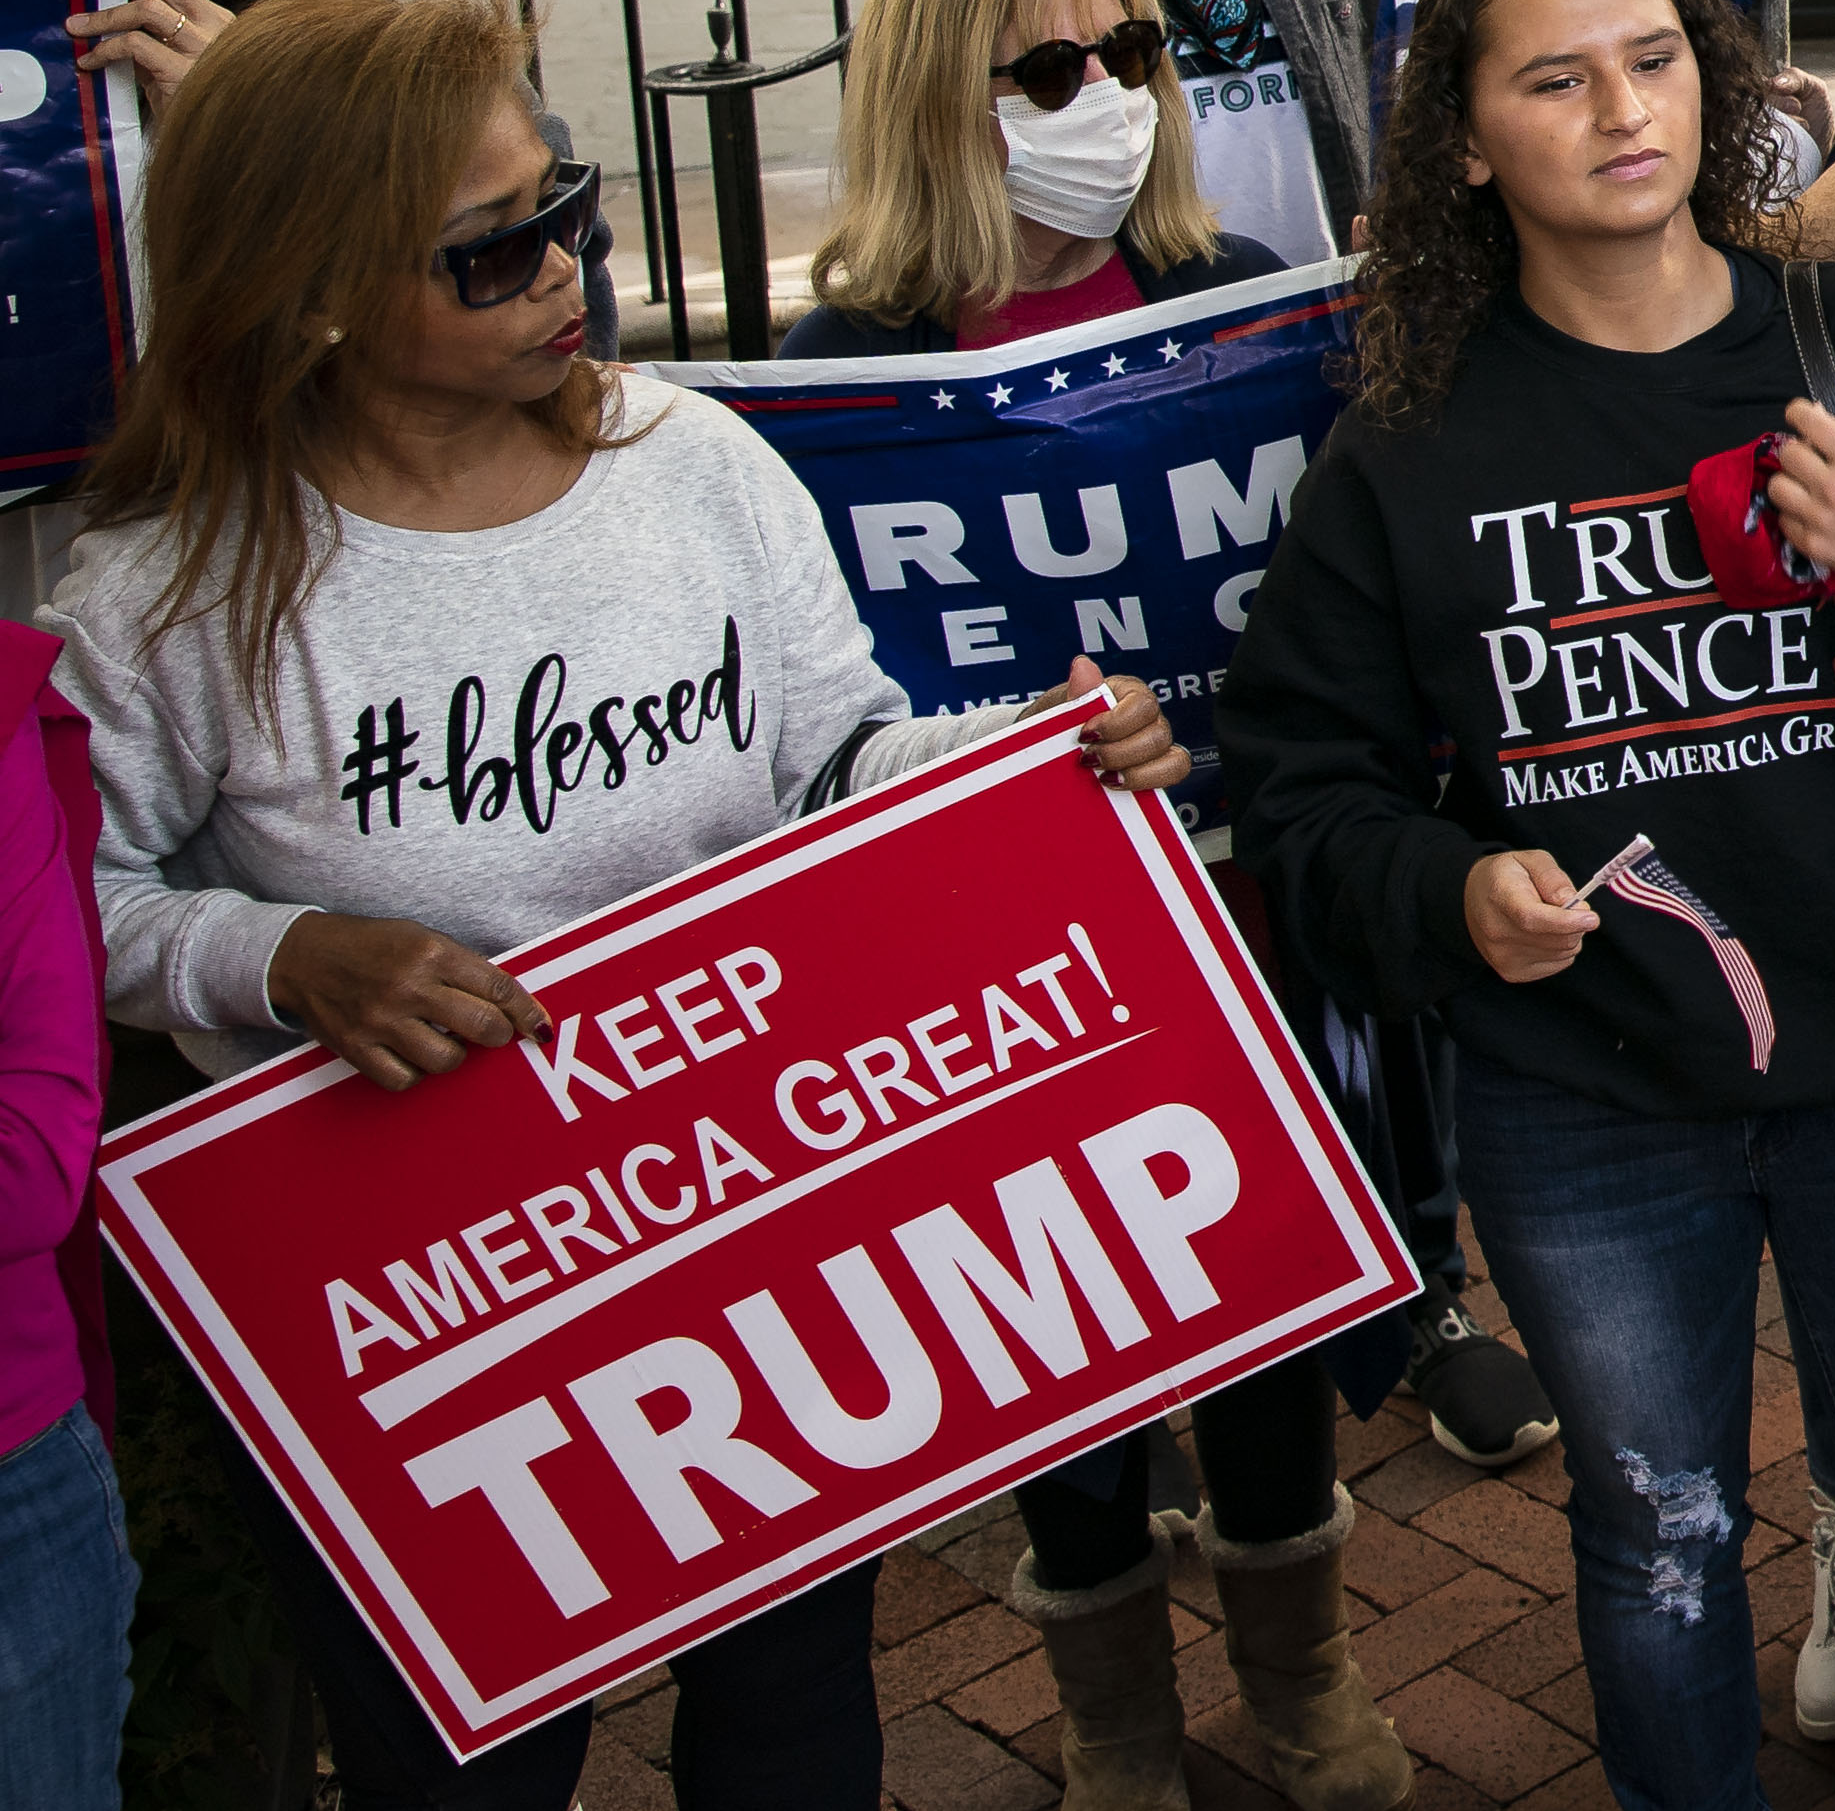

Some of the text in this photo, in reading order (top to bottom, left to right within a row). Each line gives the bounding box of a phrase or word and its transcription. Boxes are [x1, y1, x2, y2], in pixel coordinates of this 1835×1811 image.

[849, 434, 1311, 592] RUM
[1470, 501, 1715, 615] TRU
[939, 568, 1268, 668] ENC
[1479, 605, 1820, 739] PENCE
[339, 615, 758, 837] #blessed
[1502, 759, 1610, 809] MAKE
[1613, 732, 1780, 791] AMERICA
[531, 943, 786, 1124] KEEP
[322, 920, 1132, 1380] AMERICA GREAT!
[401, 1101, 1243, 1622] TRUMP
